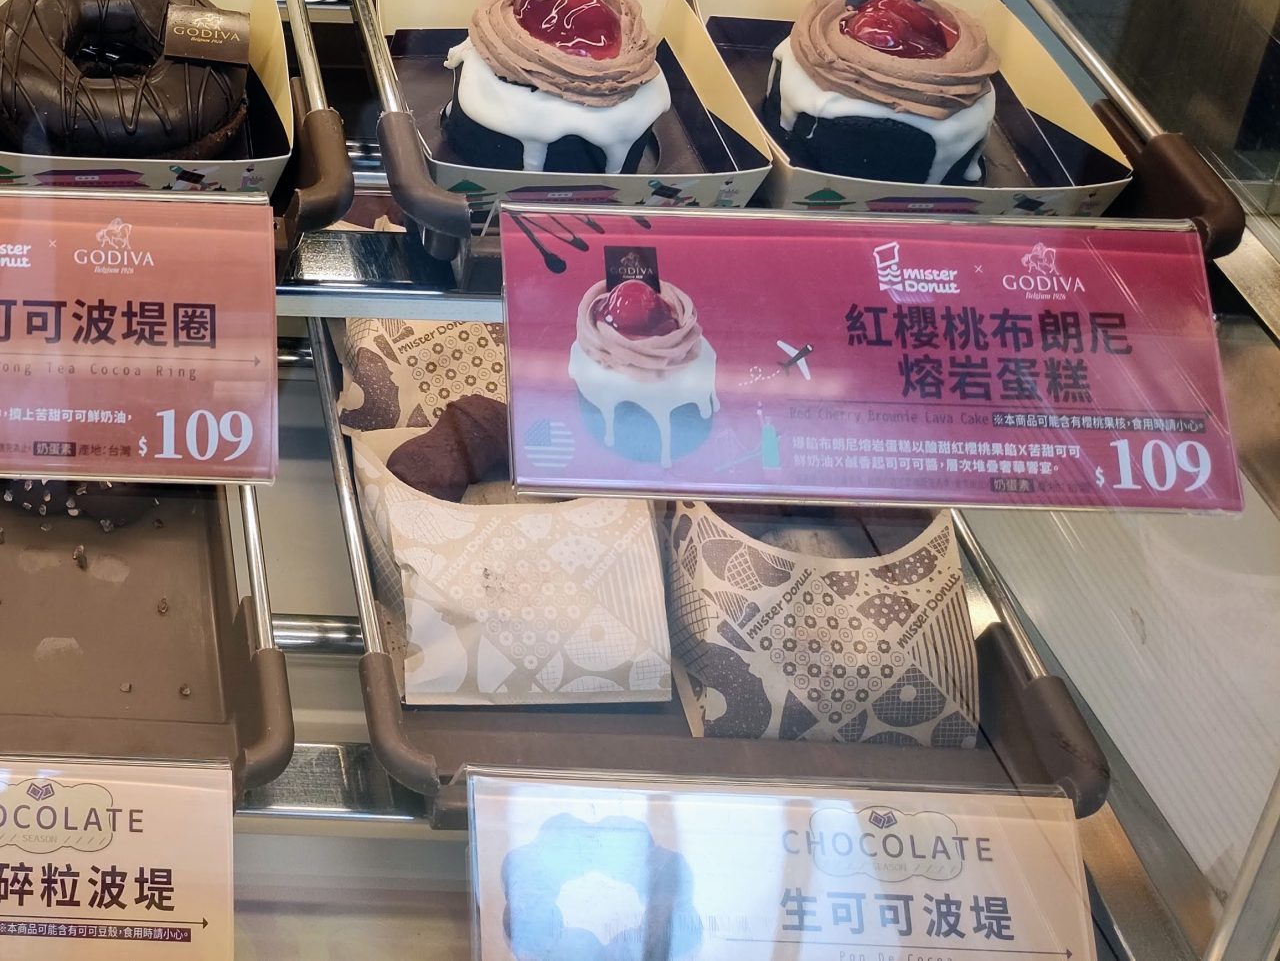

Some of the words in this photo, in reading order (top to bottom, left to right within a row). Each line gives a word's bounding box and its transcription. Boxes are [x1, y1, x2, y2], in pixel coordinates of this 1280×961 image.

[173, 26, 240, 42] GODIVA
[74, 249, 154, 267] GODIVA
[1003, 274, 1085, 293] GODIVA
[1025, 291, 1051, 301] Belgium
[845, 303, 1133, 356] 紅櫻桃布朗尼
[45, 361, 76, 374] Tea
[90, 363, 142, 377] Cocoa
[156, 365, 198, 381] Ring
[899, 353, 1093, 404] 熔岩蛋糕
[926, 413, 954, 424] Lava
[961, 413, 989, 425] Cake
[138, 409, 253, 462] $109
[35, 442, 73, 455] 奶蛋素
[1095, 439, 1212, 492] $109
[22, 834, 58, 843] SEASON
[782, 830, 994, 862] CHOCOLATE
[780, 888, 1015, 941] 生可可波堤
